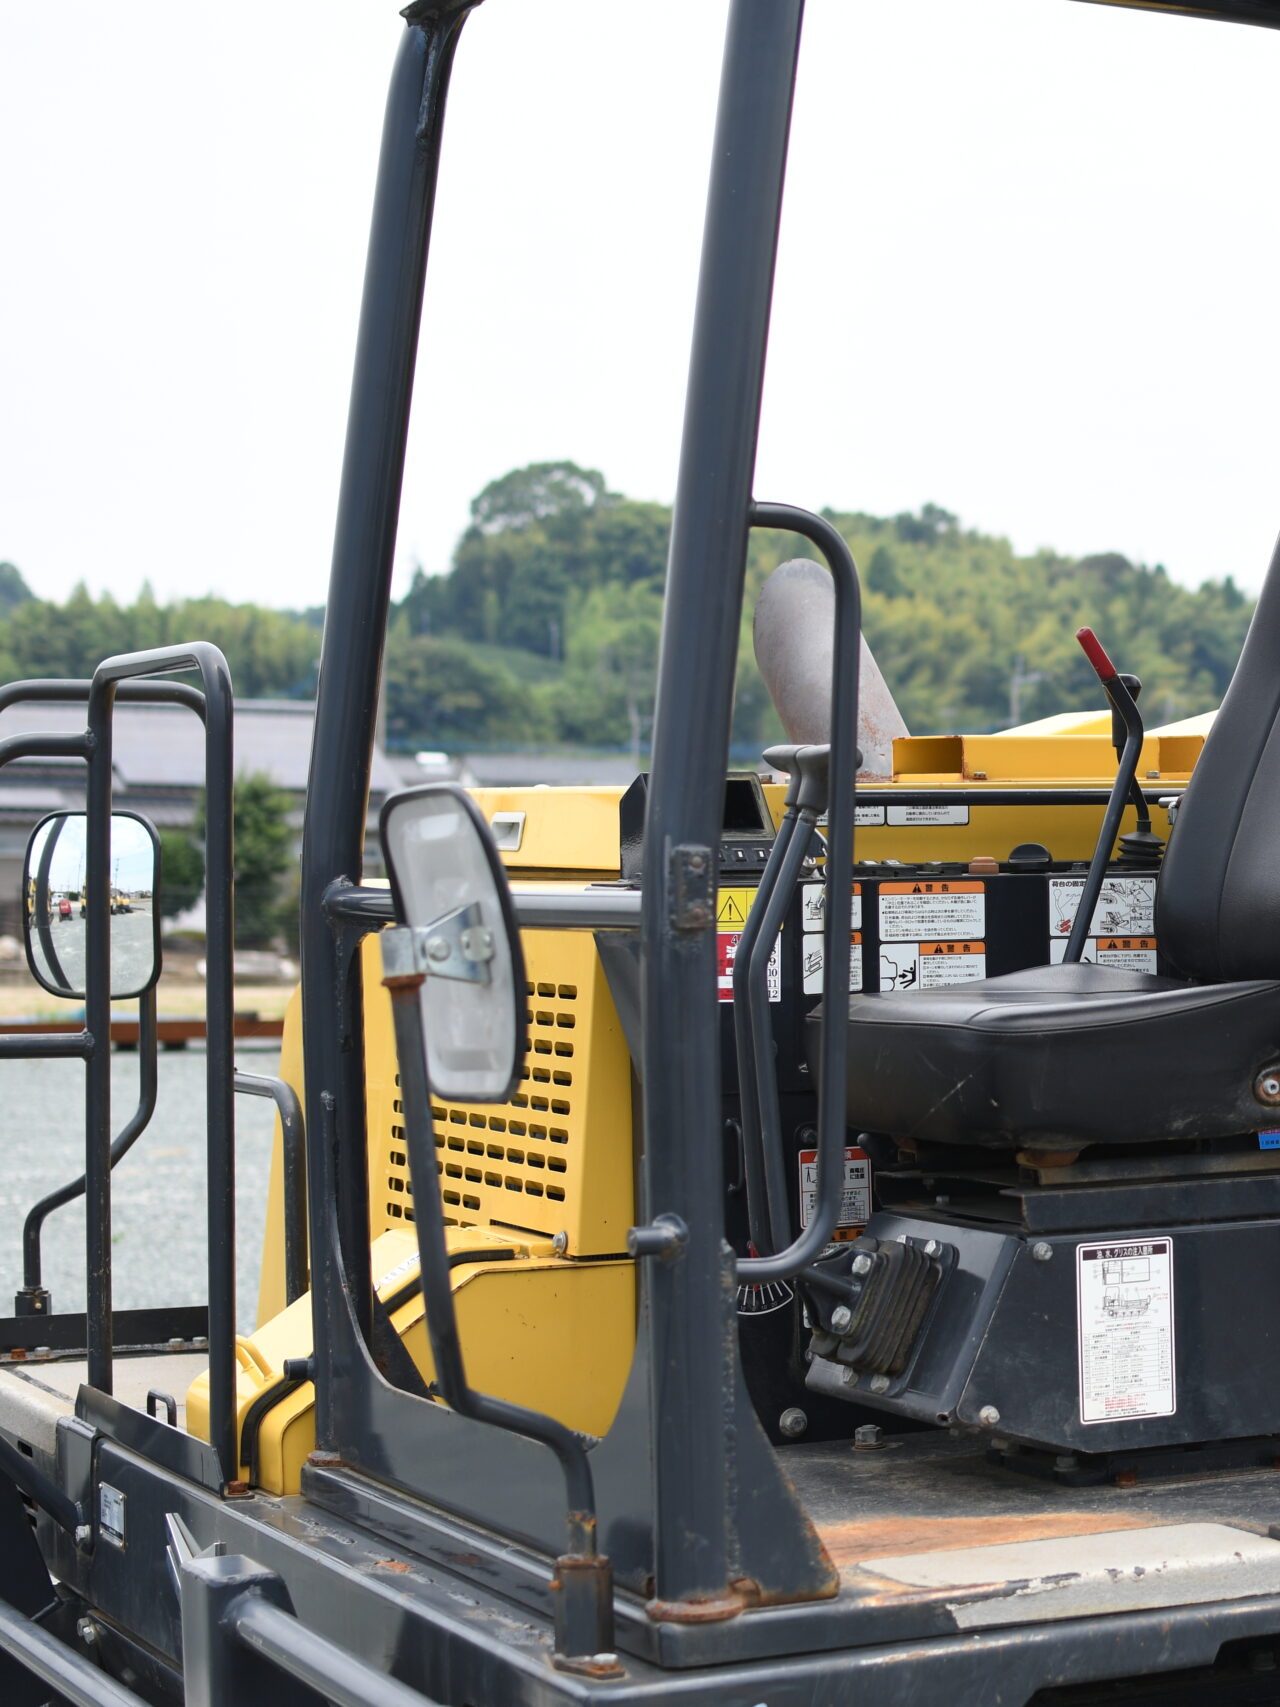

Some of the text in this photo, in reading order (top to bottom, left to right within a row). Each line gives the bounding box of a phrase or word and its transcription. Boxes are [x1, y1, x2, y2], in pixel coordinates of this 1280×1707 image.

[770, 957, 776, 966] 9
[768, 968, 778, 977] 10
[768, 979, 777, 988] 11
[768, 990, 778, 998] 12
